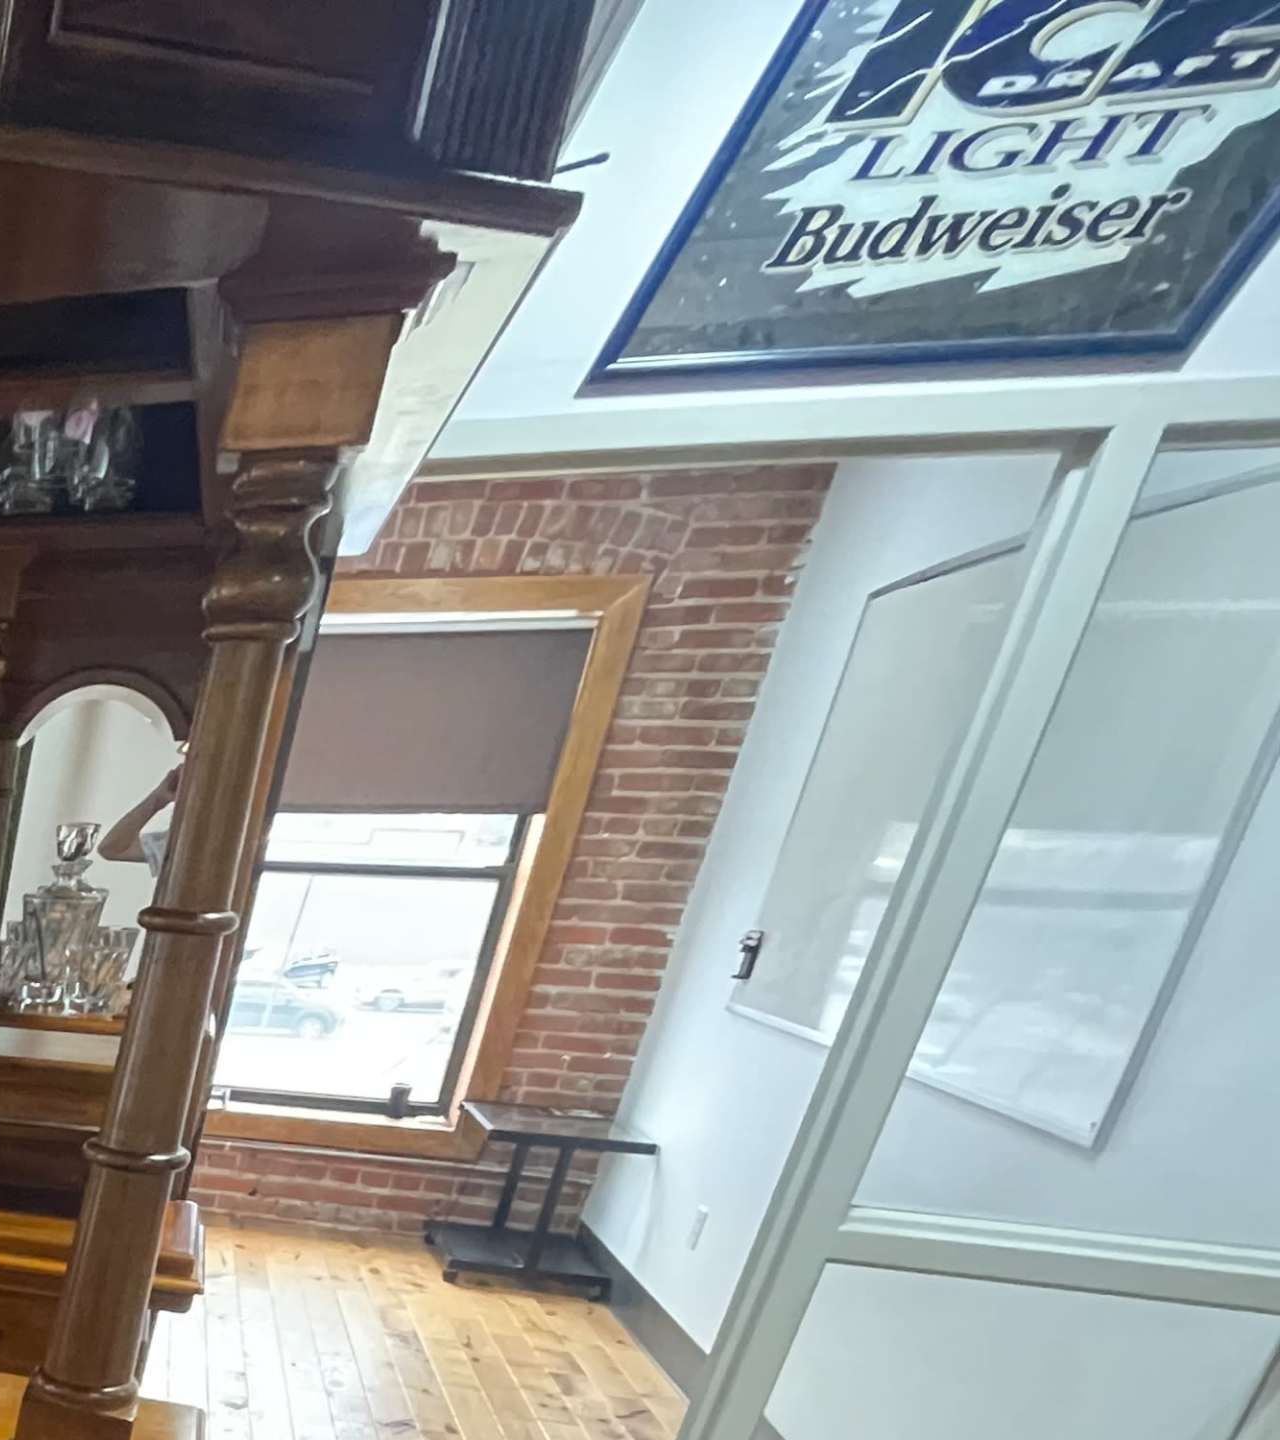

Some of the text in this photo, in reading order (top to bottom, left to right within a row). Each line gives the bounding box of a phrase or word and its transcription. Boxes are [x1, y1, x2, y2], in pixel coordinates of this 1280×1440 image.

[976, 47, 1274, 97] DRAFT
[849, 105, 1217, 182] LIGHT
[761, 182, 1192, 272] Budweiser
